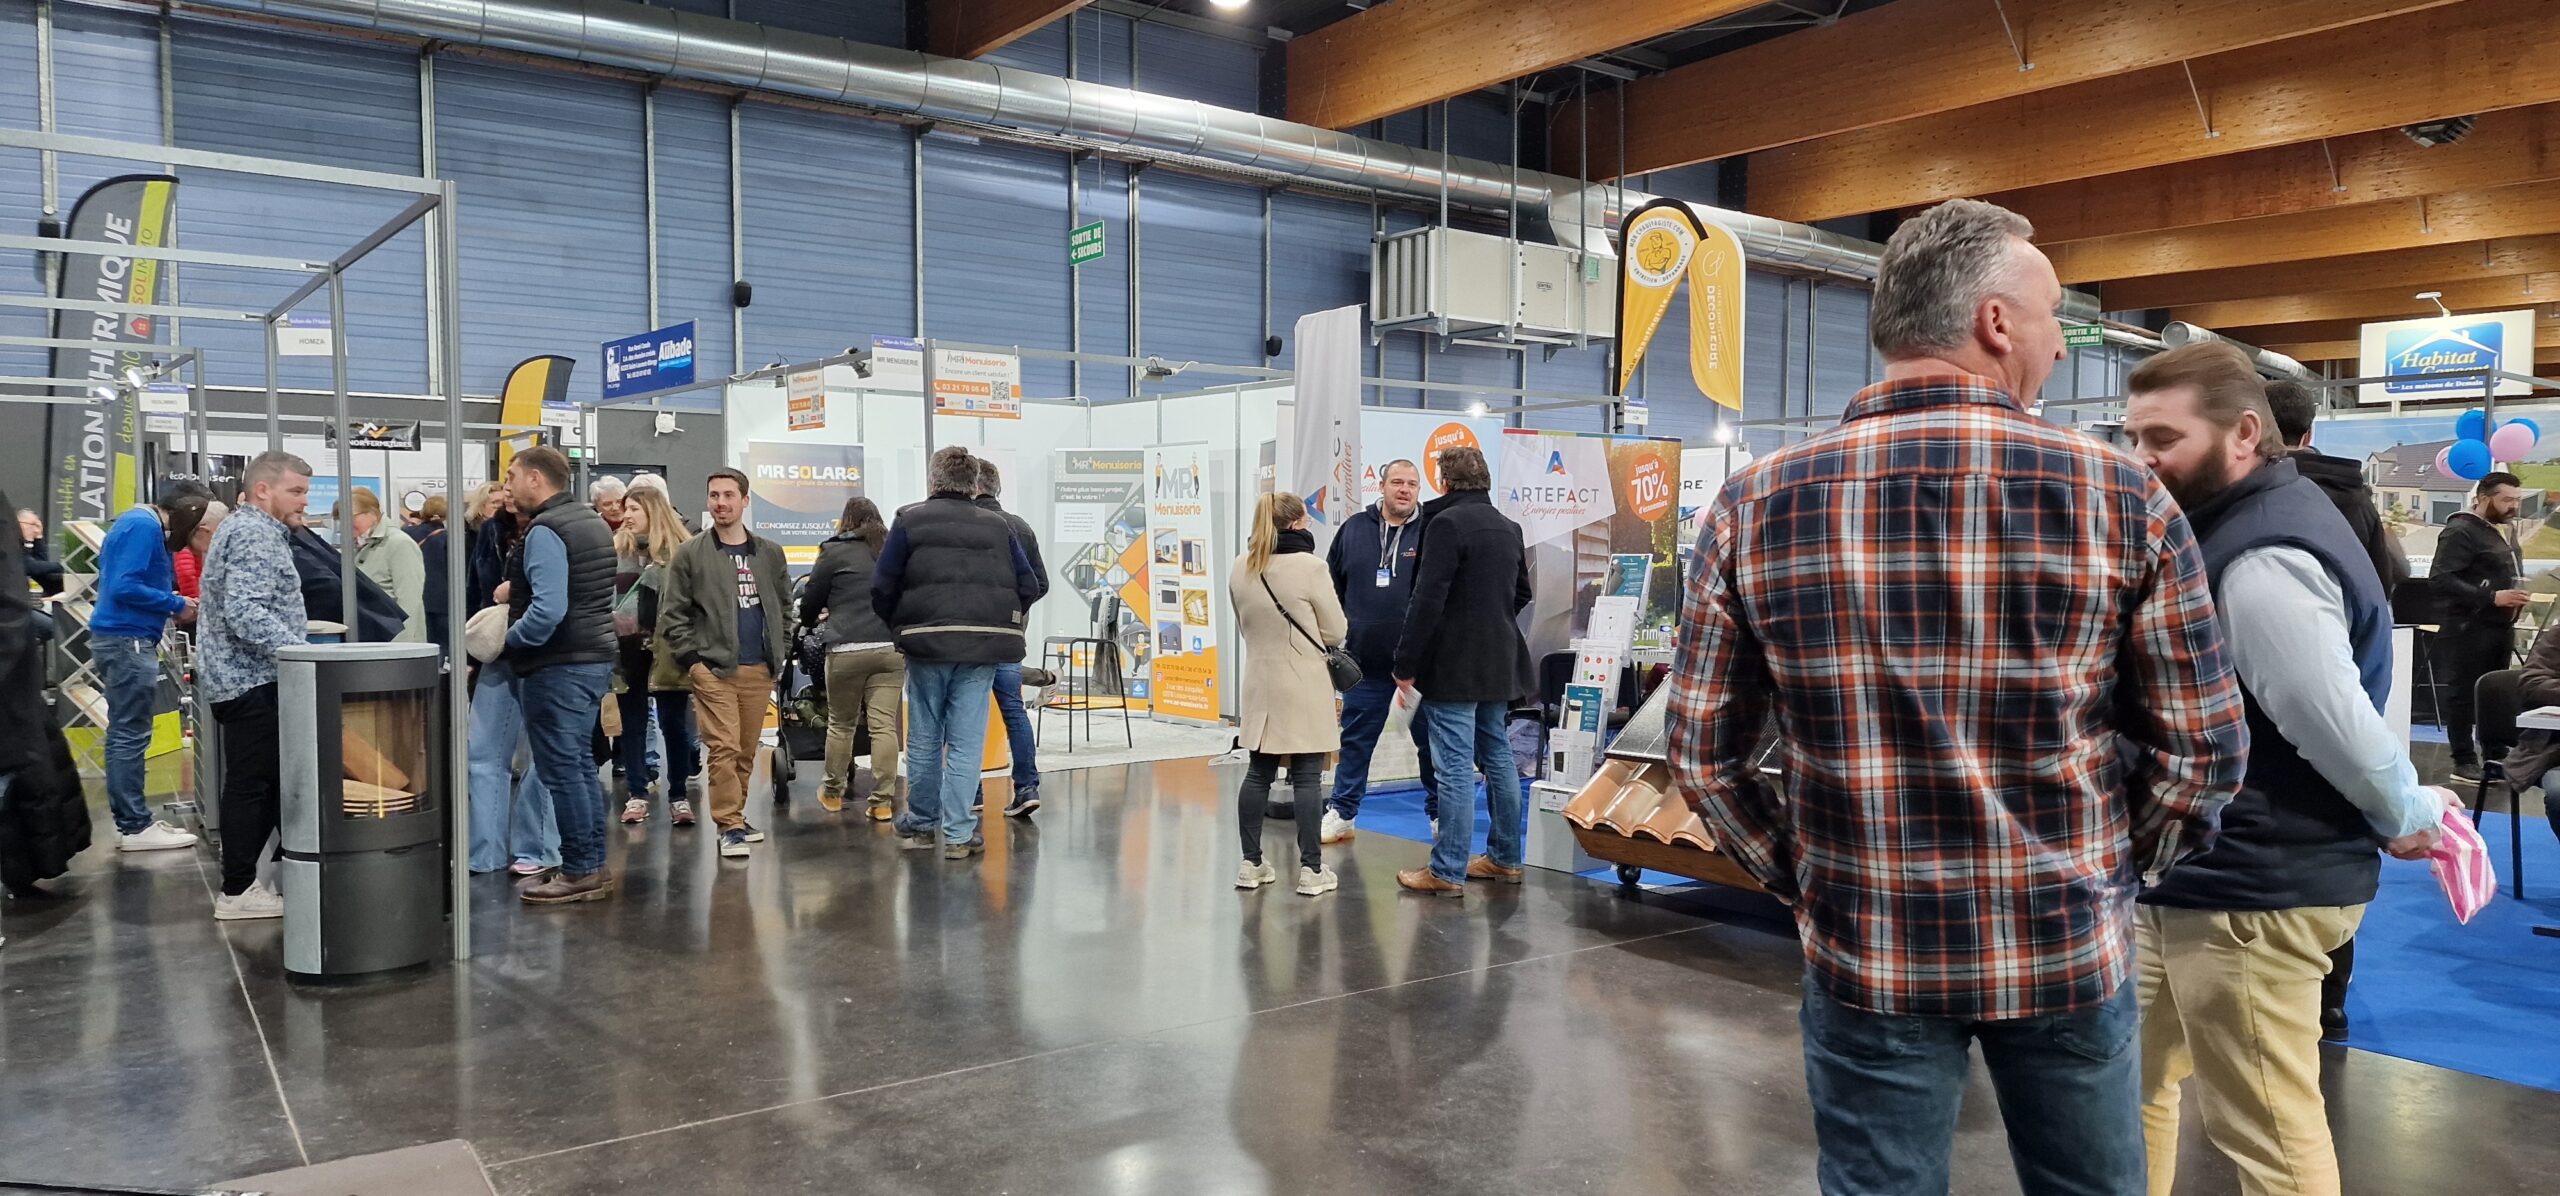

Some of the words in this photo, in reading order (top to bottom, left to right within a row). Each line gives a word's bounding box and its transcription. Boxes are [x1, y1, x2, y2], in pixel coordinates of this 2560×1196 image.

[1072, 230, 1092, 247] SORTIE
[1093, 226, 1102, 240] DE
[1077, 241, 1102, 259] SECOURS
[2063, 328, 2088, 336] SORTIE
[2090, 327, 2100, 335] DE
[2069, 335, 2100, 344] SECOURS
[965, 355, 1007, 367] Menuiserie
[2401, 349, 2478, 368] Habitat
[2414, 382, 2444, 390] maisons
[2455, 379, 2484, 388] Demain
[1434, 428, 1465, 448] jusqu'à
[757, 465, 785, 479] MR
[1092, 460, 1143, 470] Menuiserie
[1634, 458, 1660, 478] jusqu'à
[1163, 467, 1194, 499] MR
[1631, 470, 1669, 506] 70%
[1509, 487, 1600, 504] ARTEFACT
[1154, 501, 1201, 516] Menuiserie
